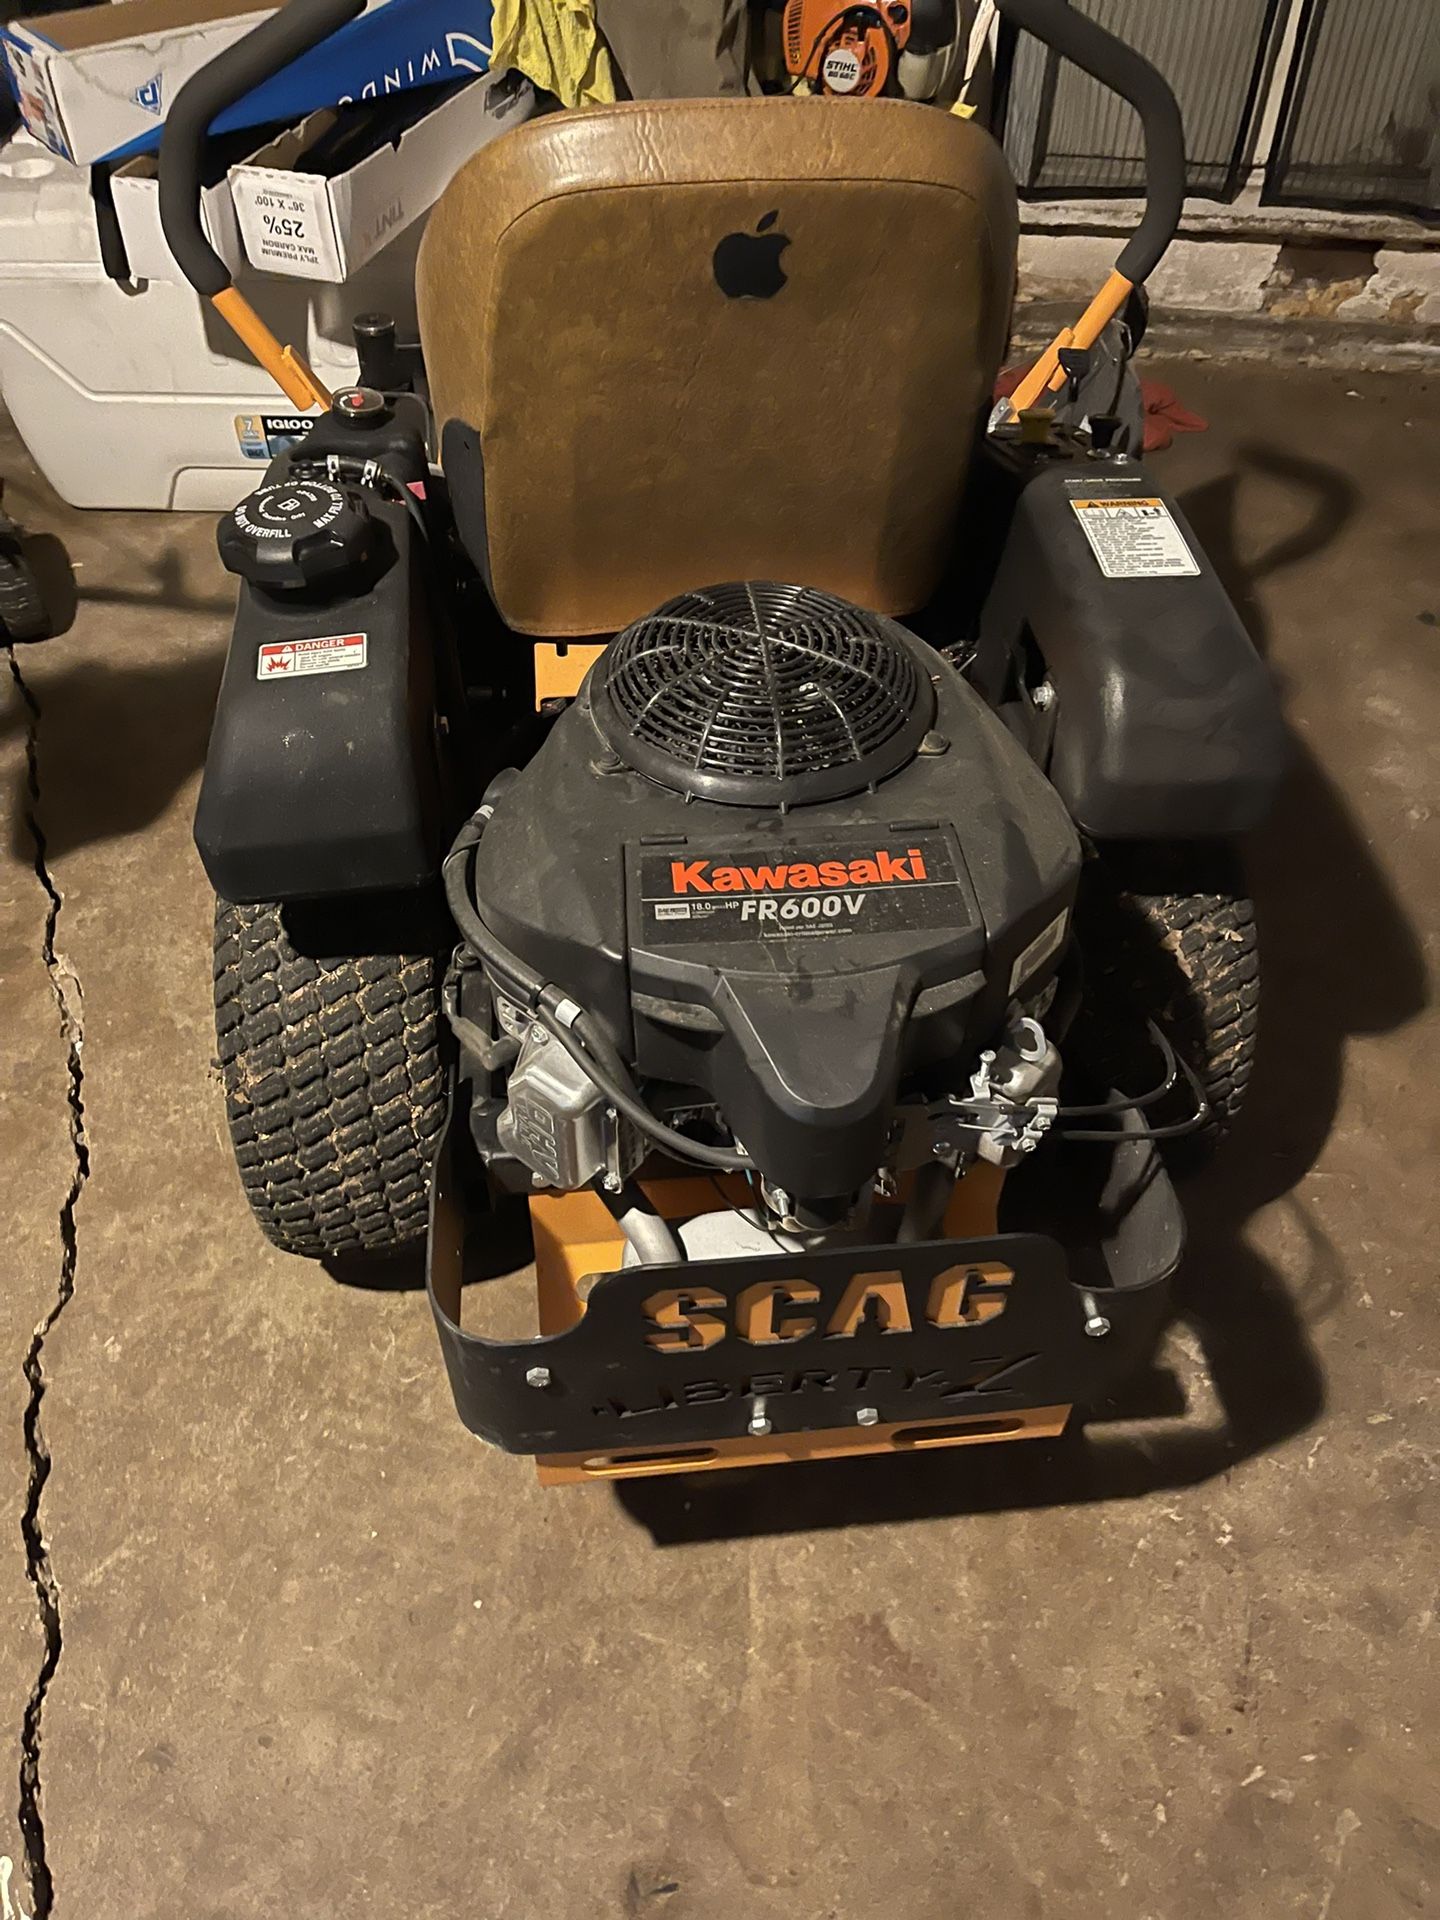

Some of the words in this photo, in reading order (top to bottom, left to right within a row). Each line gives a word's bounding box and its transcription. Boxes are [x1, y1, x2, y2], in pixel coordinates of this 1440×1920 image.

[826, 60, 858, 72] STIHL
[263, 214, 304, 238] 25%
[262, 239, 296, 252] CARBON
[297, 244, 315, 255] MAX
[262, 247, 298, 261] PREMIUM
[266, 419, 314, 430] IGLOO
[300, 481, 338, 494] BOTTOM
[235, 505, 247, 516] DO
[328, 501, 343, 515] FILL
[235, 515, 250, 528] NOT
[313, 512, 335, 528] MAX
[245, 524, 292, 538] OVERFILL
[295, 639, 345, 652] DANGER
[671, 847, 928, 894] Kawasaki
[691, 902, 711, 911] 18.0
[740, 893, 867, 922] FR600V
[640, 1261, 1016, 1355] SCAG
[604, 1366, 946, 1418] LIBERTY
